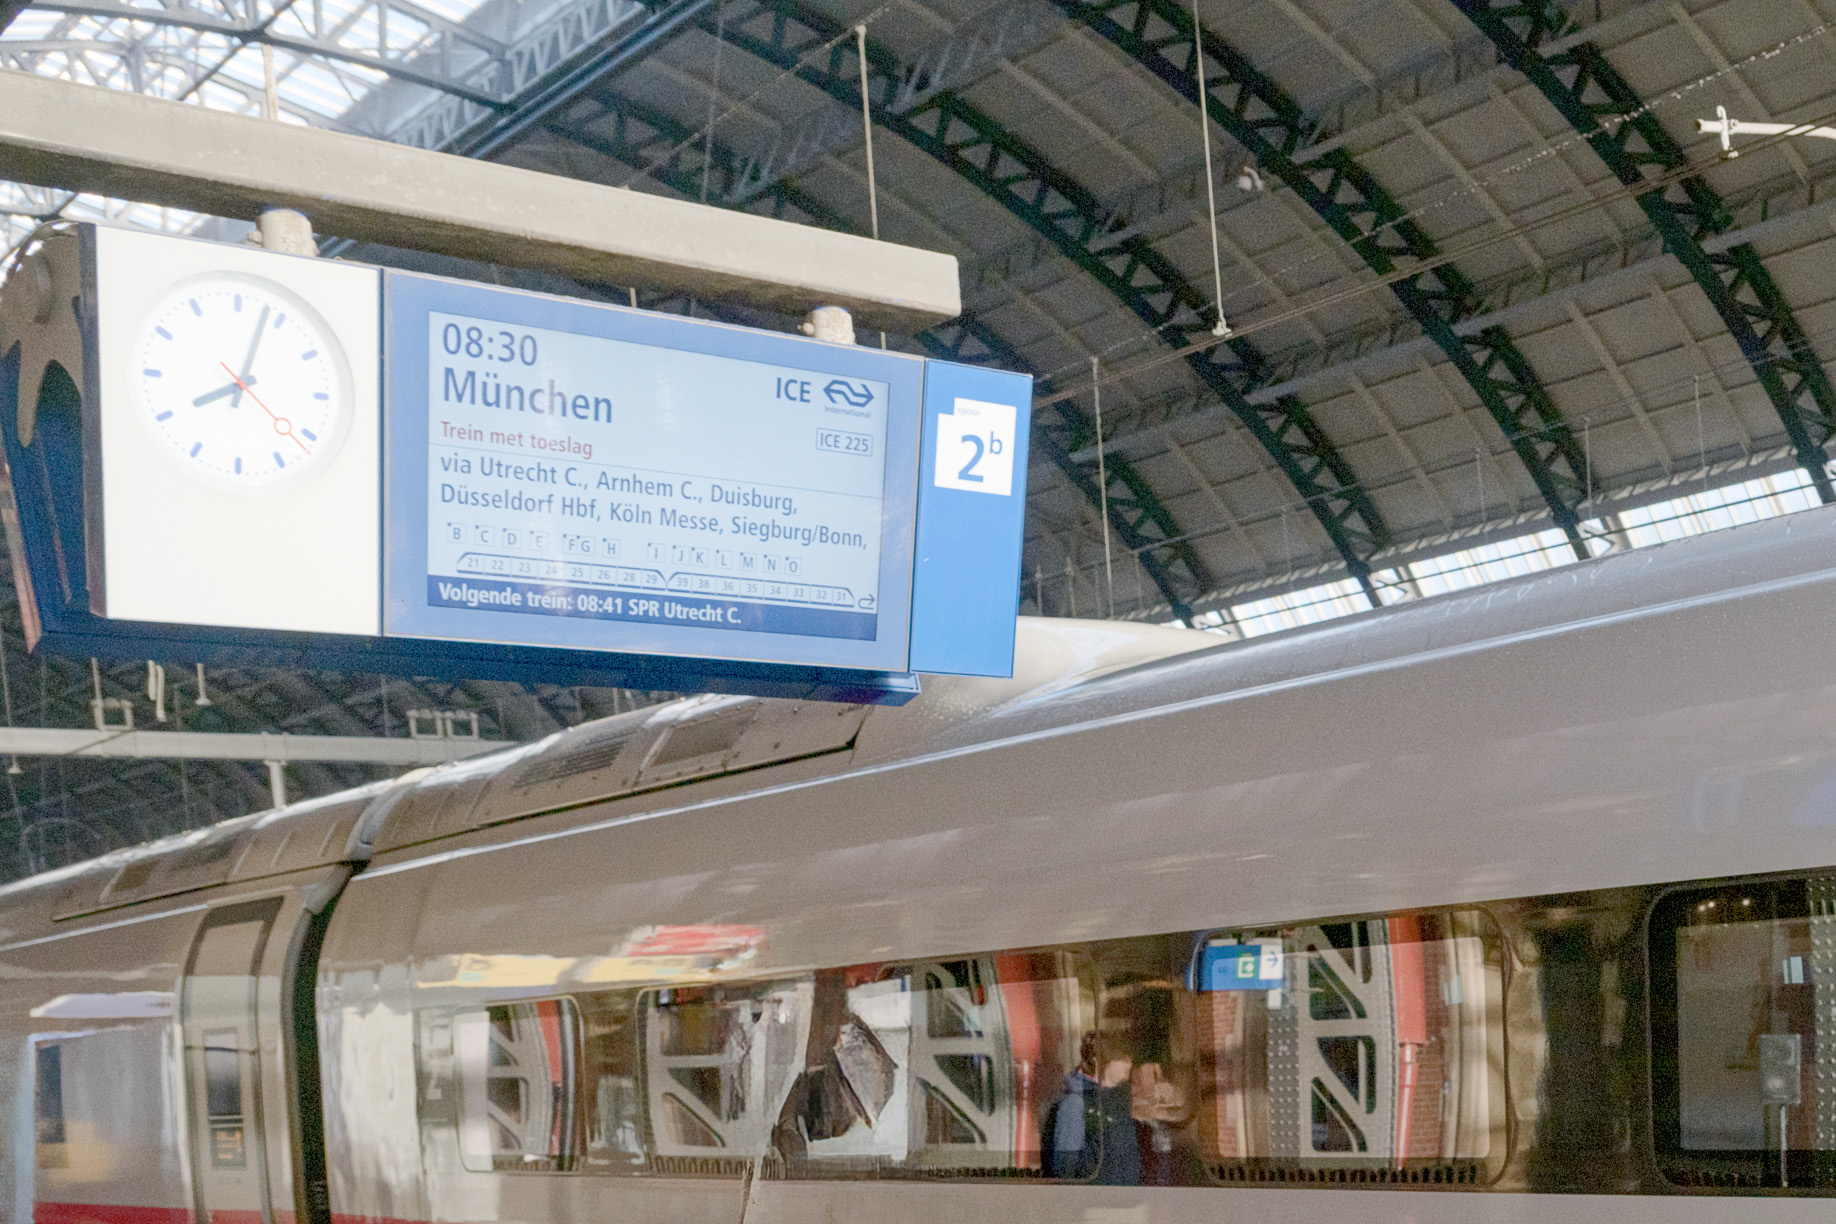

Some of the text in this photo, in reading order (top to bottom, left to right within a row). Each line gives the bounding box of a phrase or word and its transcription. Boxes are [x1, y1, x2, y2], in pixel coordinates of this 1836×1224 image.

[442, 322, 538, 366] 08:30
[443, 366, 613, 423] München
[776, 377, 811, 403] ICE
[824, 405, 872, 418] International
[957, 407, 981, 417] spoor
[441, 421, 593, 460] Trein met toeslag
[819, 432, 869, 453] ICE 225
[441, 452, 471, 475] via
[480, 456, 557, 484] Utrecht
[596, 471, 674, 498] Arnhem
[711, 484, 798, 516] Duisburg,
[441, 483, 867, 550] Düsseldorf Hbf, Köln Messe, Siegburg/Bonn,
[453, 527, 462, 540] B
[480, 529, 489, 543] C
[507, 532, 517, 545] D
[536, 535, 543, 548] E
[569, 538, 577, 551] F
[581, 540, 591, 553] G
[607, 542, 616, 555] H
[696, 552, 704, 564] K
[743, 556, 754, 569] M
[768, 558, 776, 571] N
[467, 557, 846, 601] 21 22 23 24 25 26 28 29 39 38 36 35 34 33 32 31
[438, 582, 742, 624] Volgende trein: 08:41 SPR Utrecht C.
